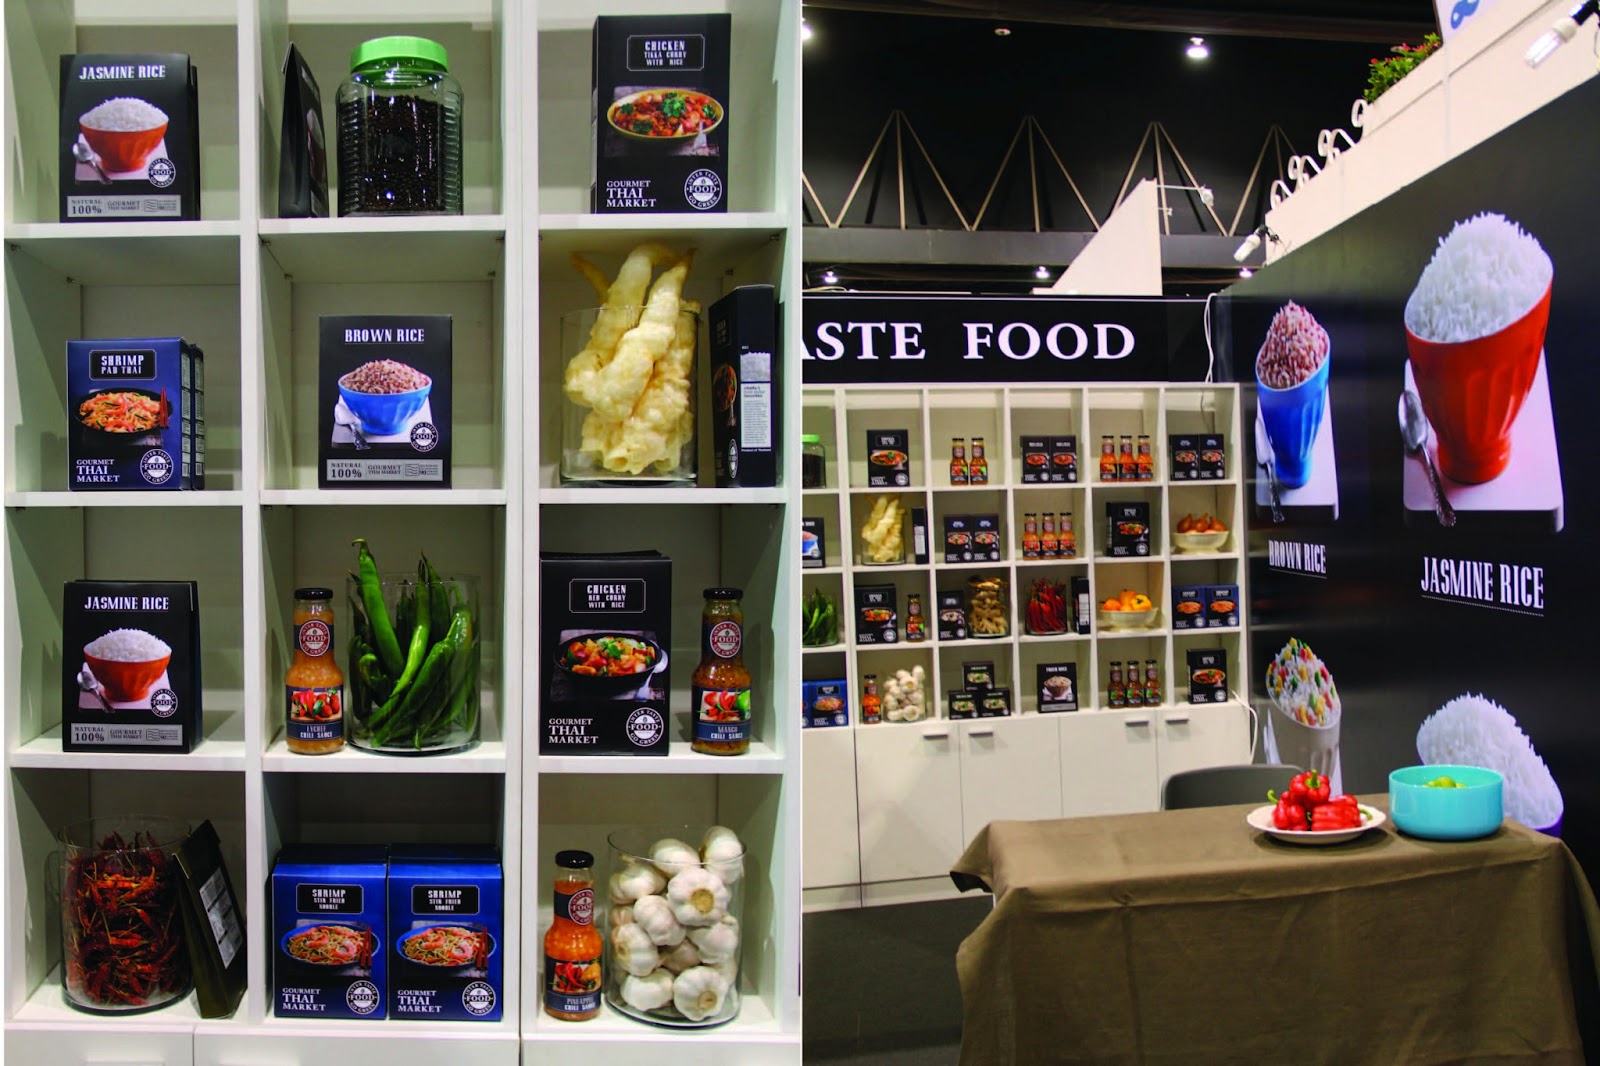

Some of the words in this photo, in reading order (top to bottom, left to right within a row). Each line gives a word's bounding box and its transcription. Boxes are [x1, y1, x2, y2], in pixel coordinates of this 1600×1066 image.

[645, 40, 685, 51] CHICKEN
[79, 66, 135, 80] JASMINE
[138, 65, 166, 78] RICE
[688, 171, 703, 185] INTER
[705, 171, 719, 185] TASTE
[606, 188, 643, 199] THAI
[689, 185, 717, 193] FOOD
[606, 199, 656, 208] MARKET
[688, 195, 697, 204] GO
[697, 195, 717, 207] GREEN
[72, 205, 102, 214] 100%
[344, 329, 393, 343] BROWN
[396, 329, 425, 342] RICE
[962, 321, 1135, 360] FOOD
[101, 355, 144, 366] SHRIMP
[101, 366, 118, 375] PAD
[122, 366, 142, 374] THAI
[76, 466, 108, 475] THAI
[331, 469, 362, 478] 100%
[76, 475, 120, 483] MARKET
[1268, 539, 1302, 571] BROWN
[1304, 543, 1327, 574] RICE
[1420, 556, 1494, 602] JASMINE
[1499, 563, 1544, 609] RICE
[587, 584, 627, 594] CHICKEN
[84, 597, 138, 610] JASMINE
[142, 597, 169, 610] RICE
[629, 710, 645, 723] INTER
[646, 710, 661, 723] TASTE
[317, 731, 332, 739] SAUCE
[548, 725, 585, 736] THAI
[75, 732, 105, 742] 100%
[548, 735, 599, 744] MARKET
[630, 733, 639, 741] GO
[639, 733, 659, 744] GREEN
[312, 889, 346, 898] SHRIMP
[427, 890, 462, 899] SHRIMP
[282, 987, 321, 995] GOURMET
[282, 994, 315, 1004] THAI
[397, 995, 431, 1006] THAI
[282, 1003, 326, 1011] MARKET
[397, 1005, 442, 1013] MARKET
